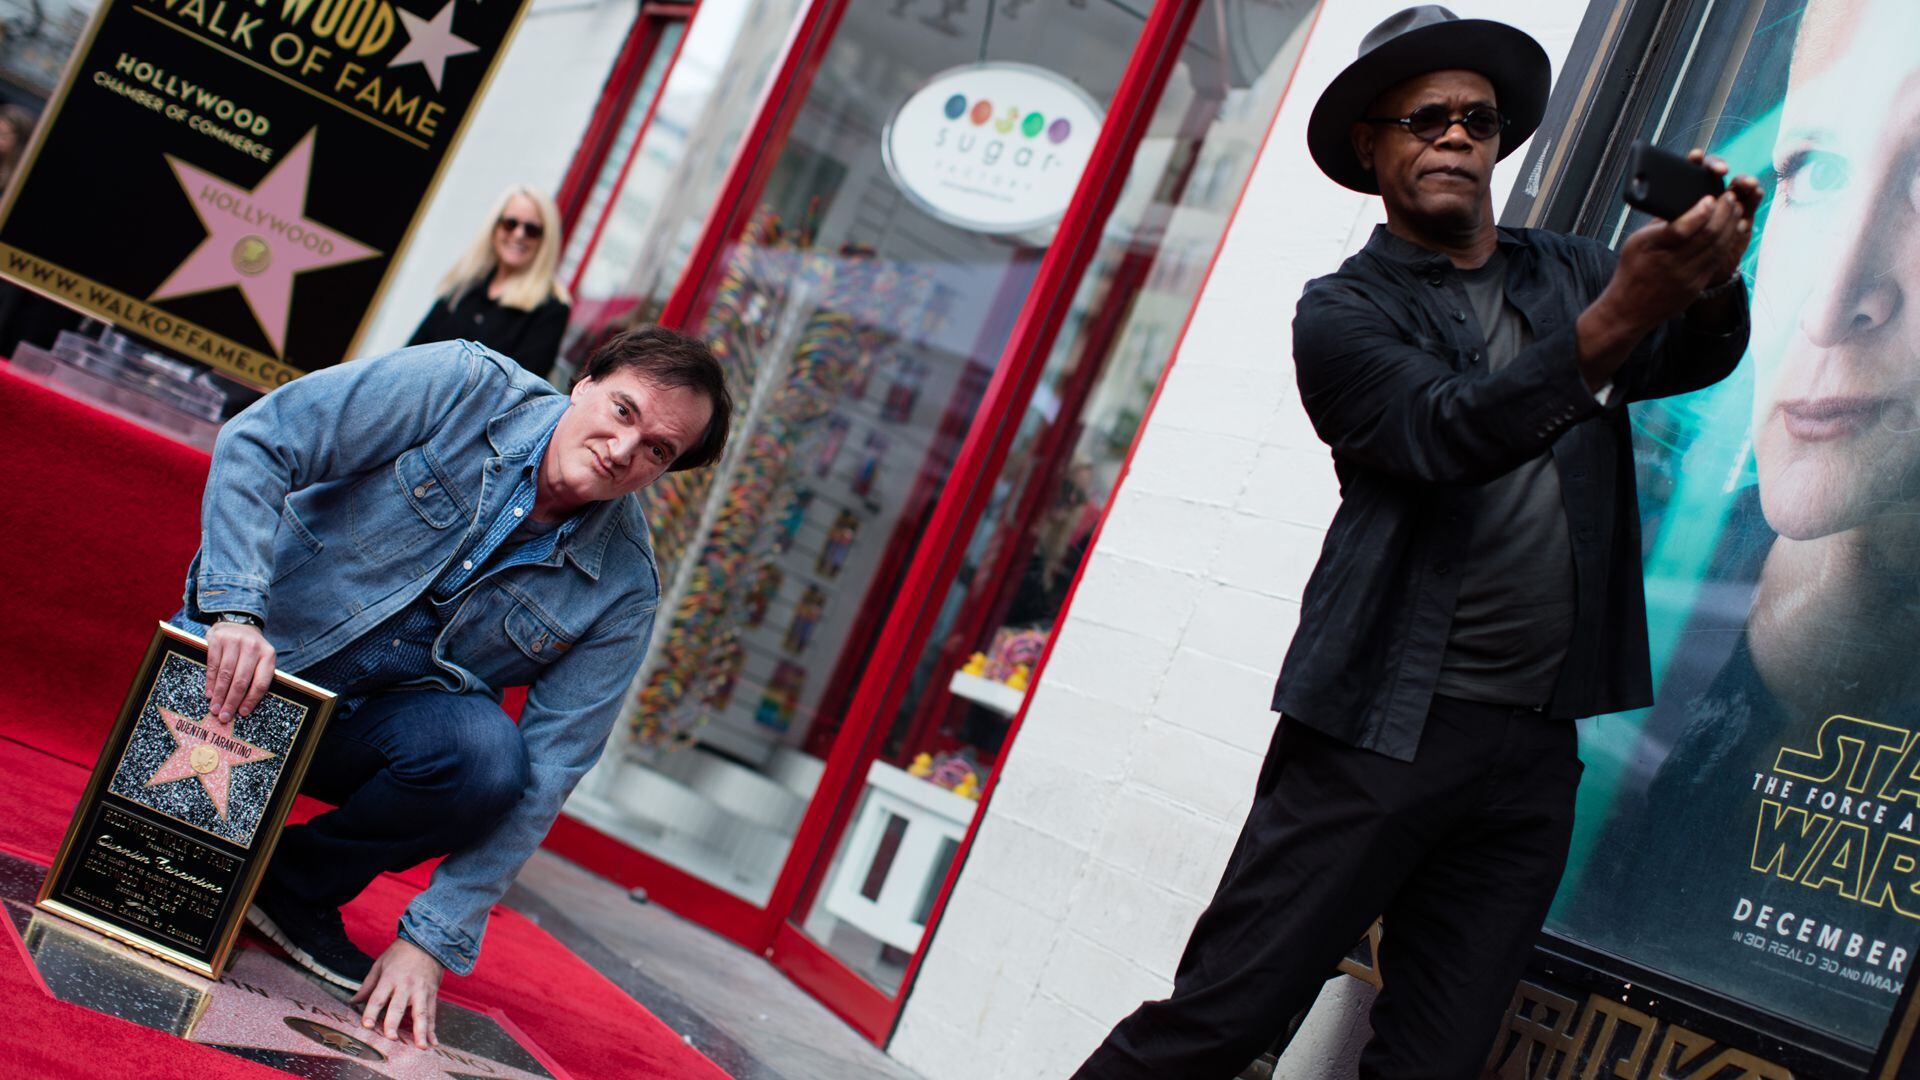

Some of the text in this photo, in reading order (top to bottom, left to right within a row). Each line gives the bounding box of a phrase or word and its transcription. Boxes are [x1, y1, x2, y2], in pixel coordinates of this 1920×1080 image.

[115, 53, 270, 136] HOLLYWOOD
[152, 0, 446, 137] ALK OF FAME
[93, 71, 274, 163] CHAMBER OF COMMERCE
[934, 126, 1056, 173] sugar
[200, 184, 334, 256] HOLLYWOOD
[175, 719, 252, 758] QUENTIN TARANTINO
[1752, 773, 1794, 799] THE
[1805, 787, 1888, 825] FORCE
[96, 835, 150, 864] Quentin
[155, 856, 223, 894] Tarantino
[1732, 897, 1908, 973] DECEMBER
[1732, 931, 1743, 943] IN
[1819, 957, 1840, 974] 3D
[1839, 967, 1861, 981] AND
[1861, 971, 1904, 996] IMAX
